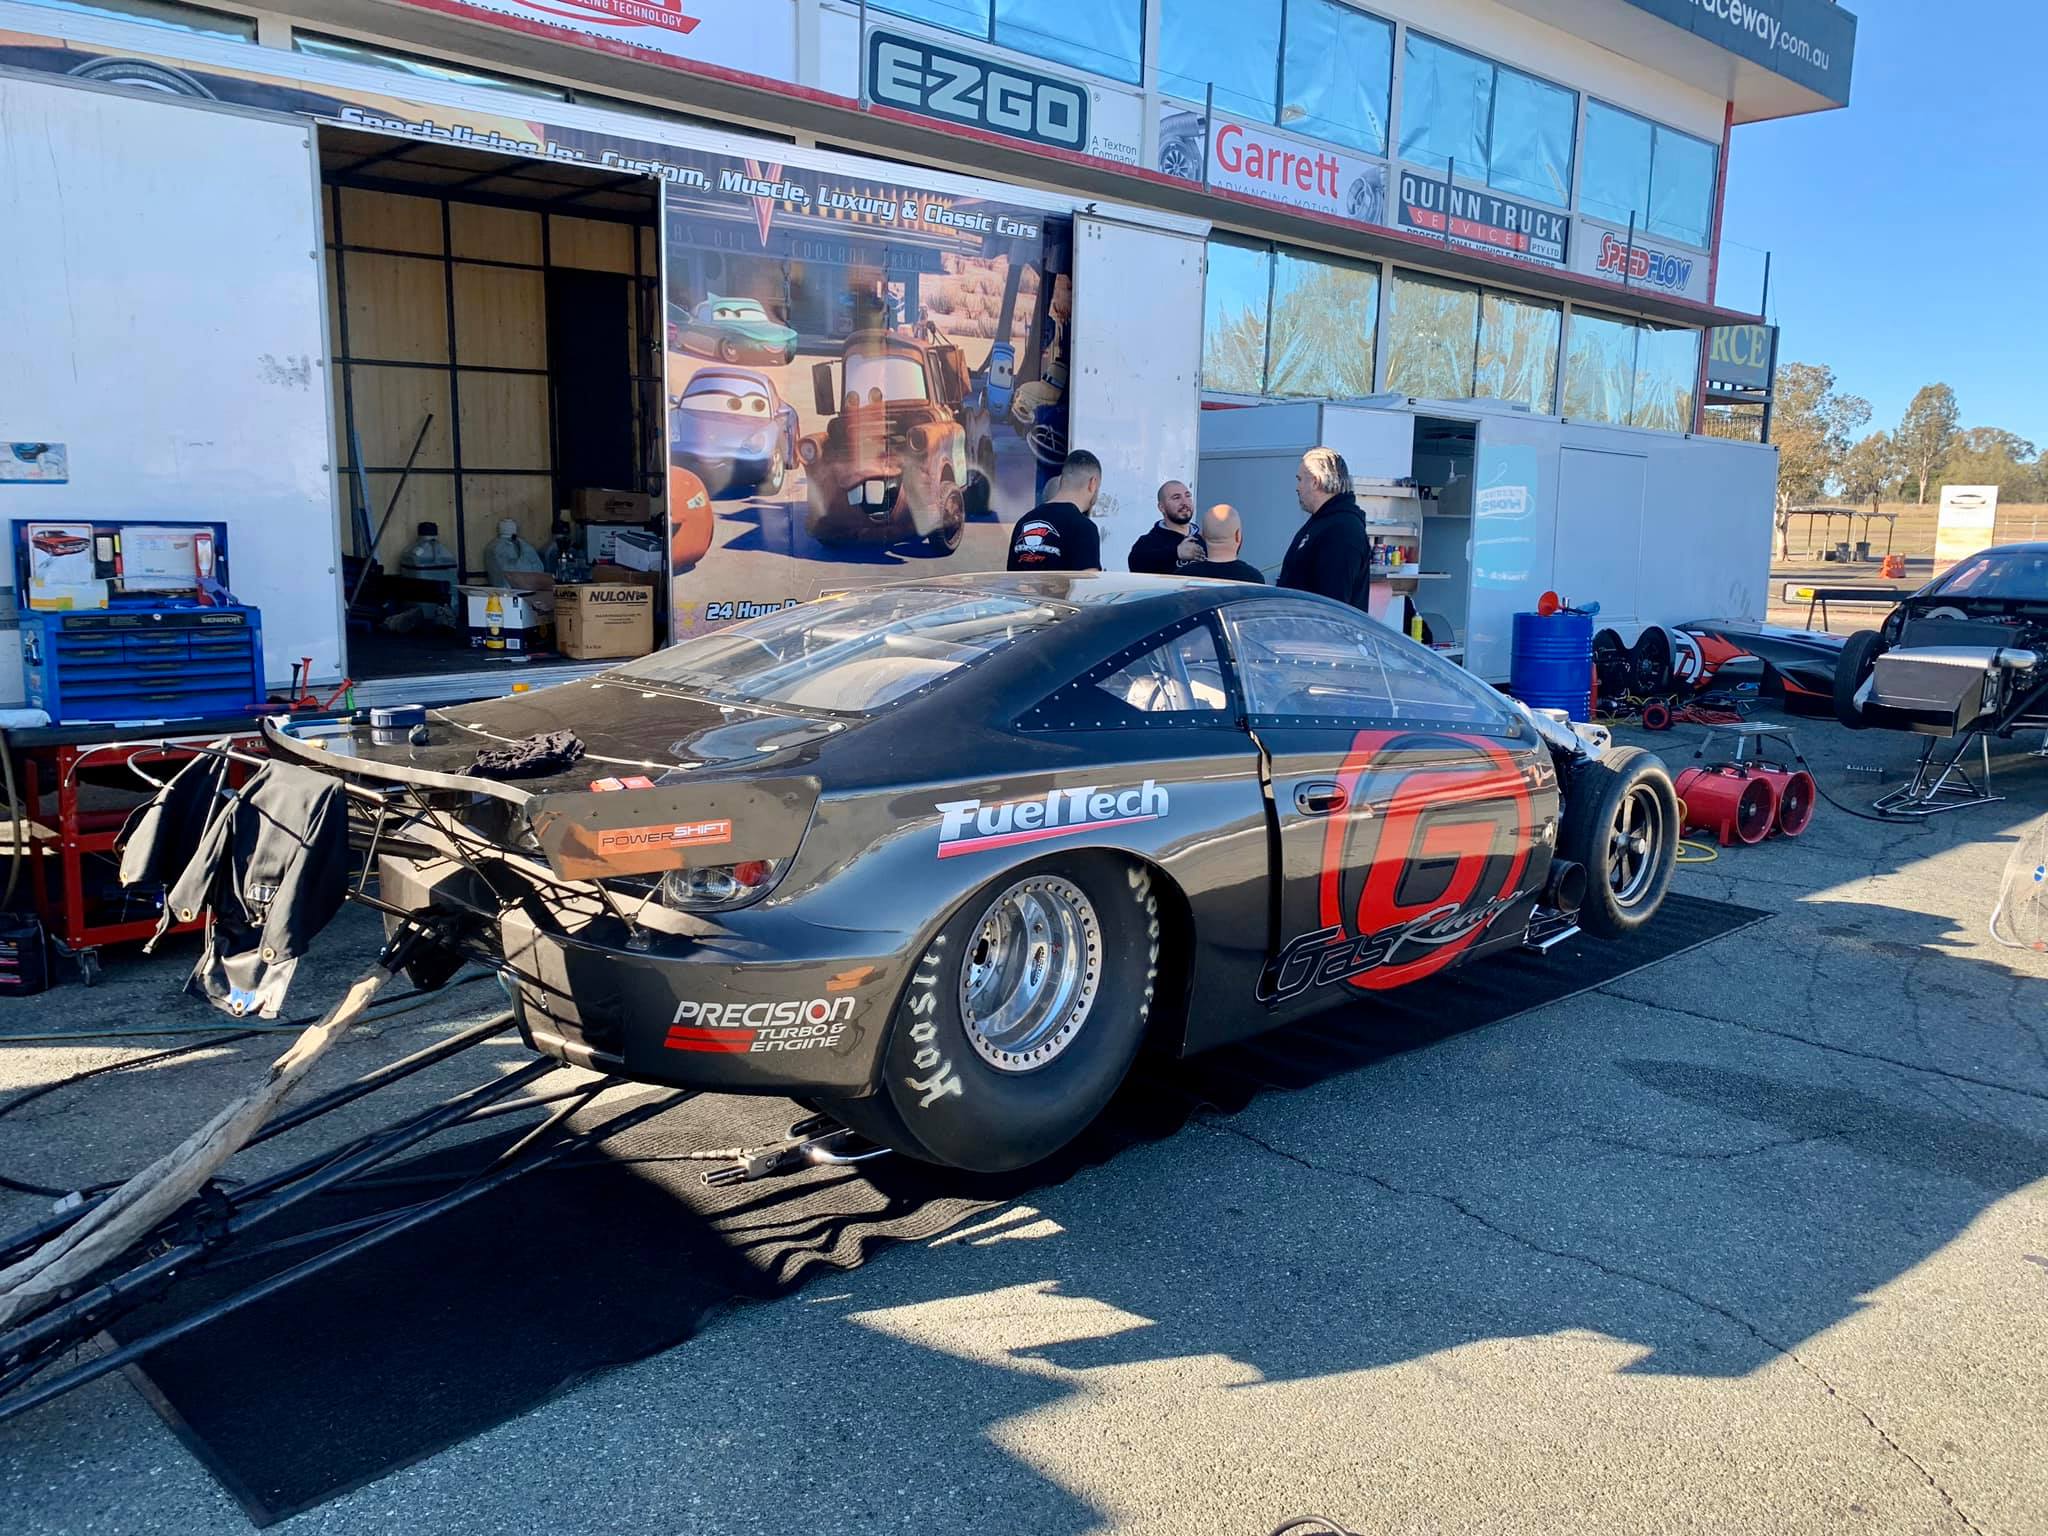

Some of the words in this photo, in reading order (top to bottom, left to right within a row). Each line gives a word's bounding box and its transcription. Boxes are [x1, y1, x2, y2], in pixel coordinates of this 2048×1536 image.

[613, 0, 682, 27] TECHNOLOGY
[877, 41, 1080, 144] EZGO
[1092, 136, 1099, 146] A
[1103, 137, 1137, 156] Textron
[1215, 123, 1341, 200] Garrett
[719, 169, 811, 206] Muscle,
[817, 185, 897, 221] Luxury
[901, 200, 918, 219] &
[923, 203, 992, 232] Classic
[996, 216, 1039, 239] Cars
[1401, 177, 1482, 221] QUINN
[1489, 200, 1564, 243] TRUCK
[1596, 232, 1693, 291] SPEEDFLOW
[589, 590, 635, 602] NULON
[706, 602, 733, 621] 24
[934, 779, 1169, 842] FuelTech
[672, 996, 856, 1028] PRECISION
[749, 1035, 841, 1053] ENGINE
[756, 1023, 826, 1041] TURBO
[830, 1022, 847, 1034] &
